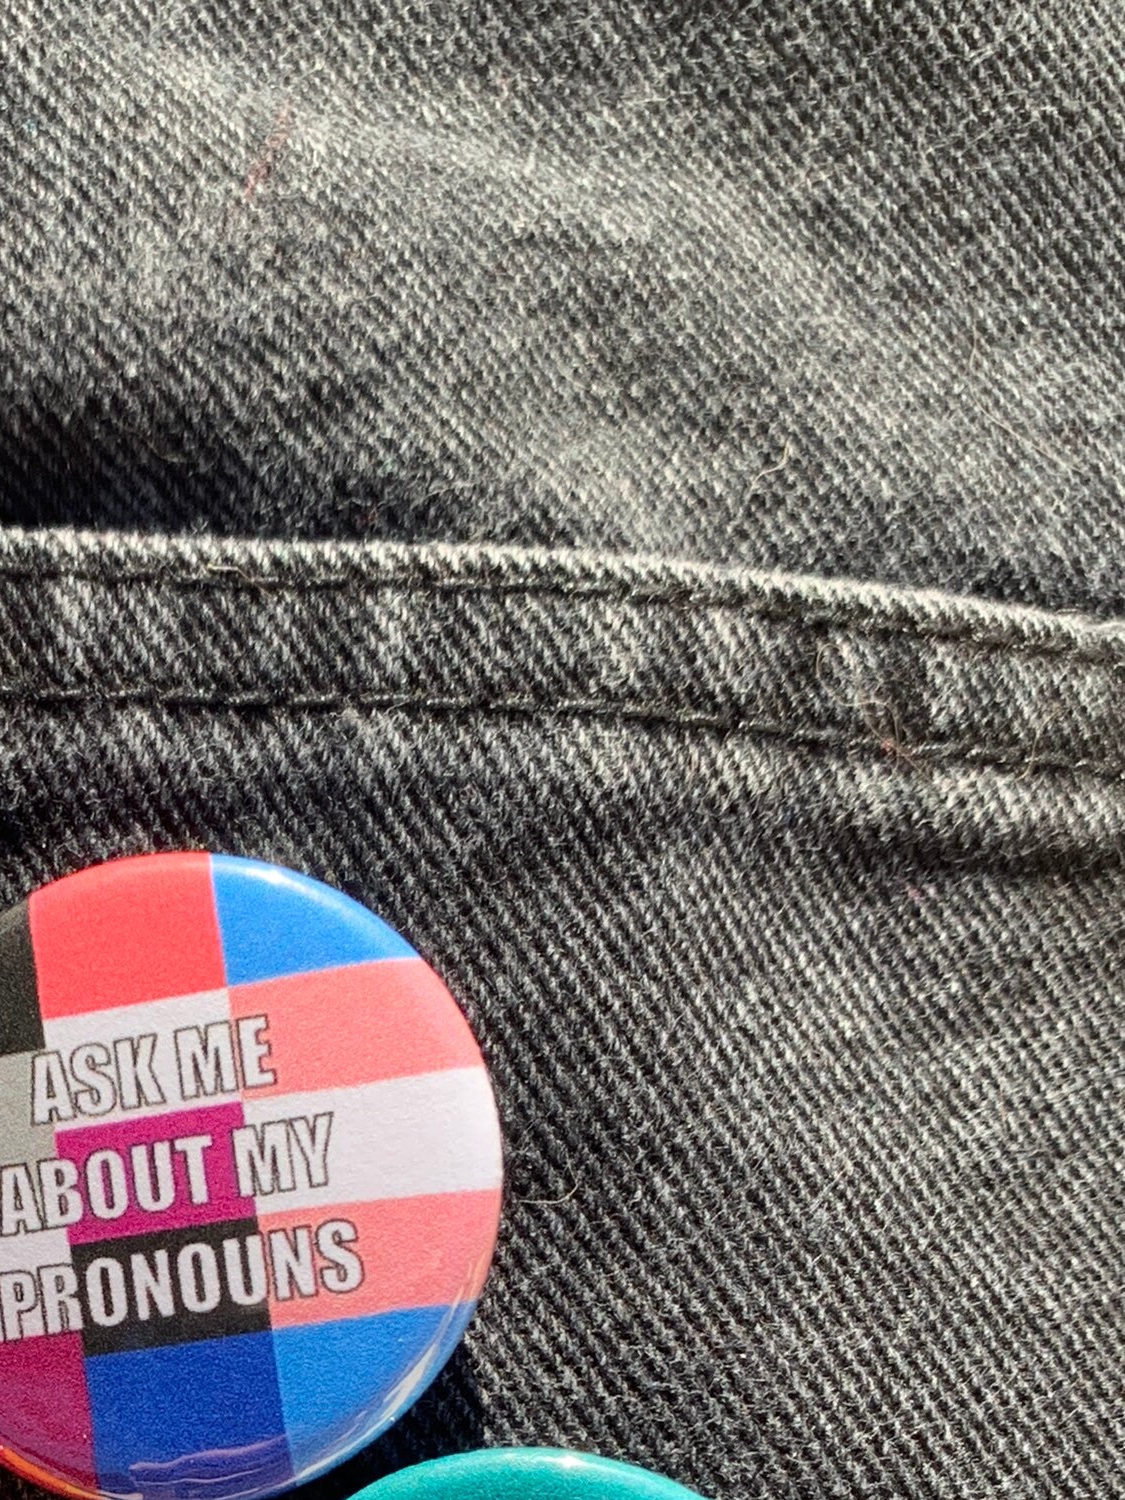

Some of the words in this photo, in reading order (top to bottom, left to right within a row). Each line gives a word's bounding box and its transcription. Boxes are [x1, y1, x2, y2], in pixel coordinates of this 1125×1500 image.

[31, 1032, 166, 1125] ASK
[174, 1014, 276, 1100] ME
[230, 1112, 334, 1196] MY
